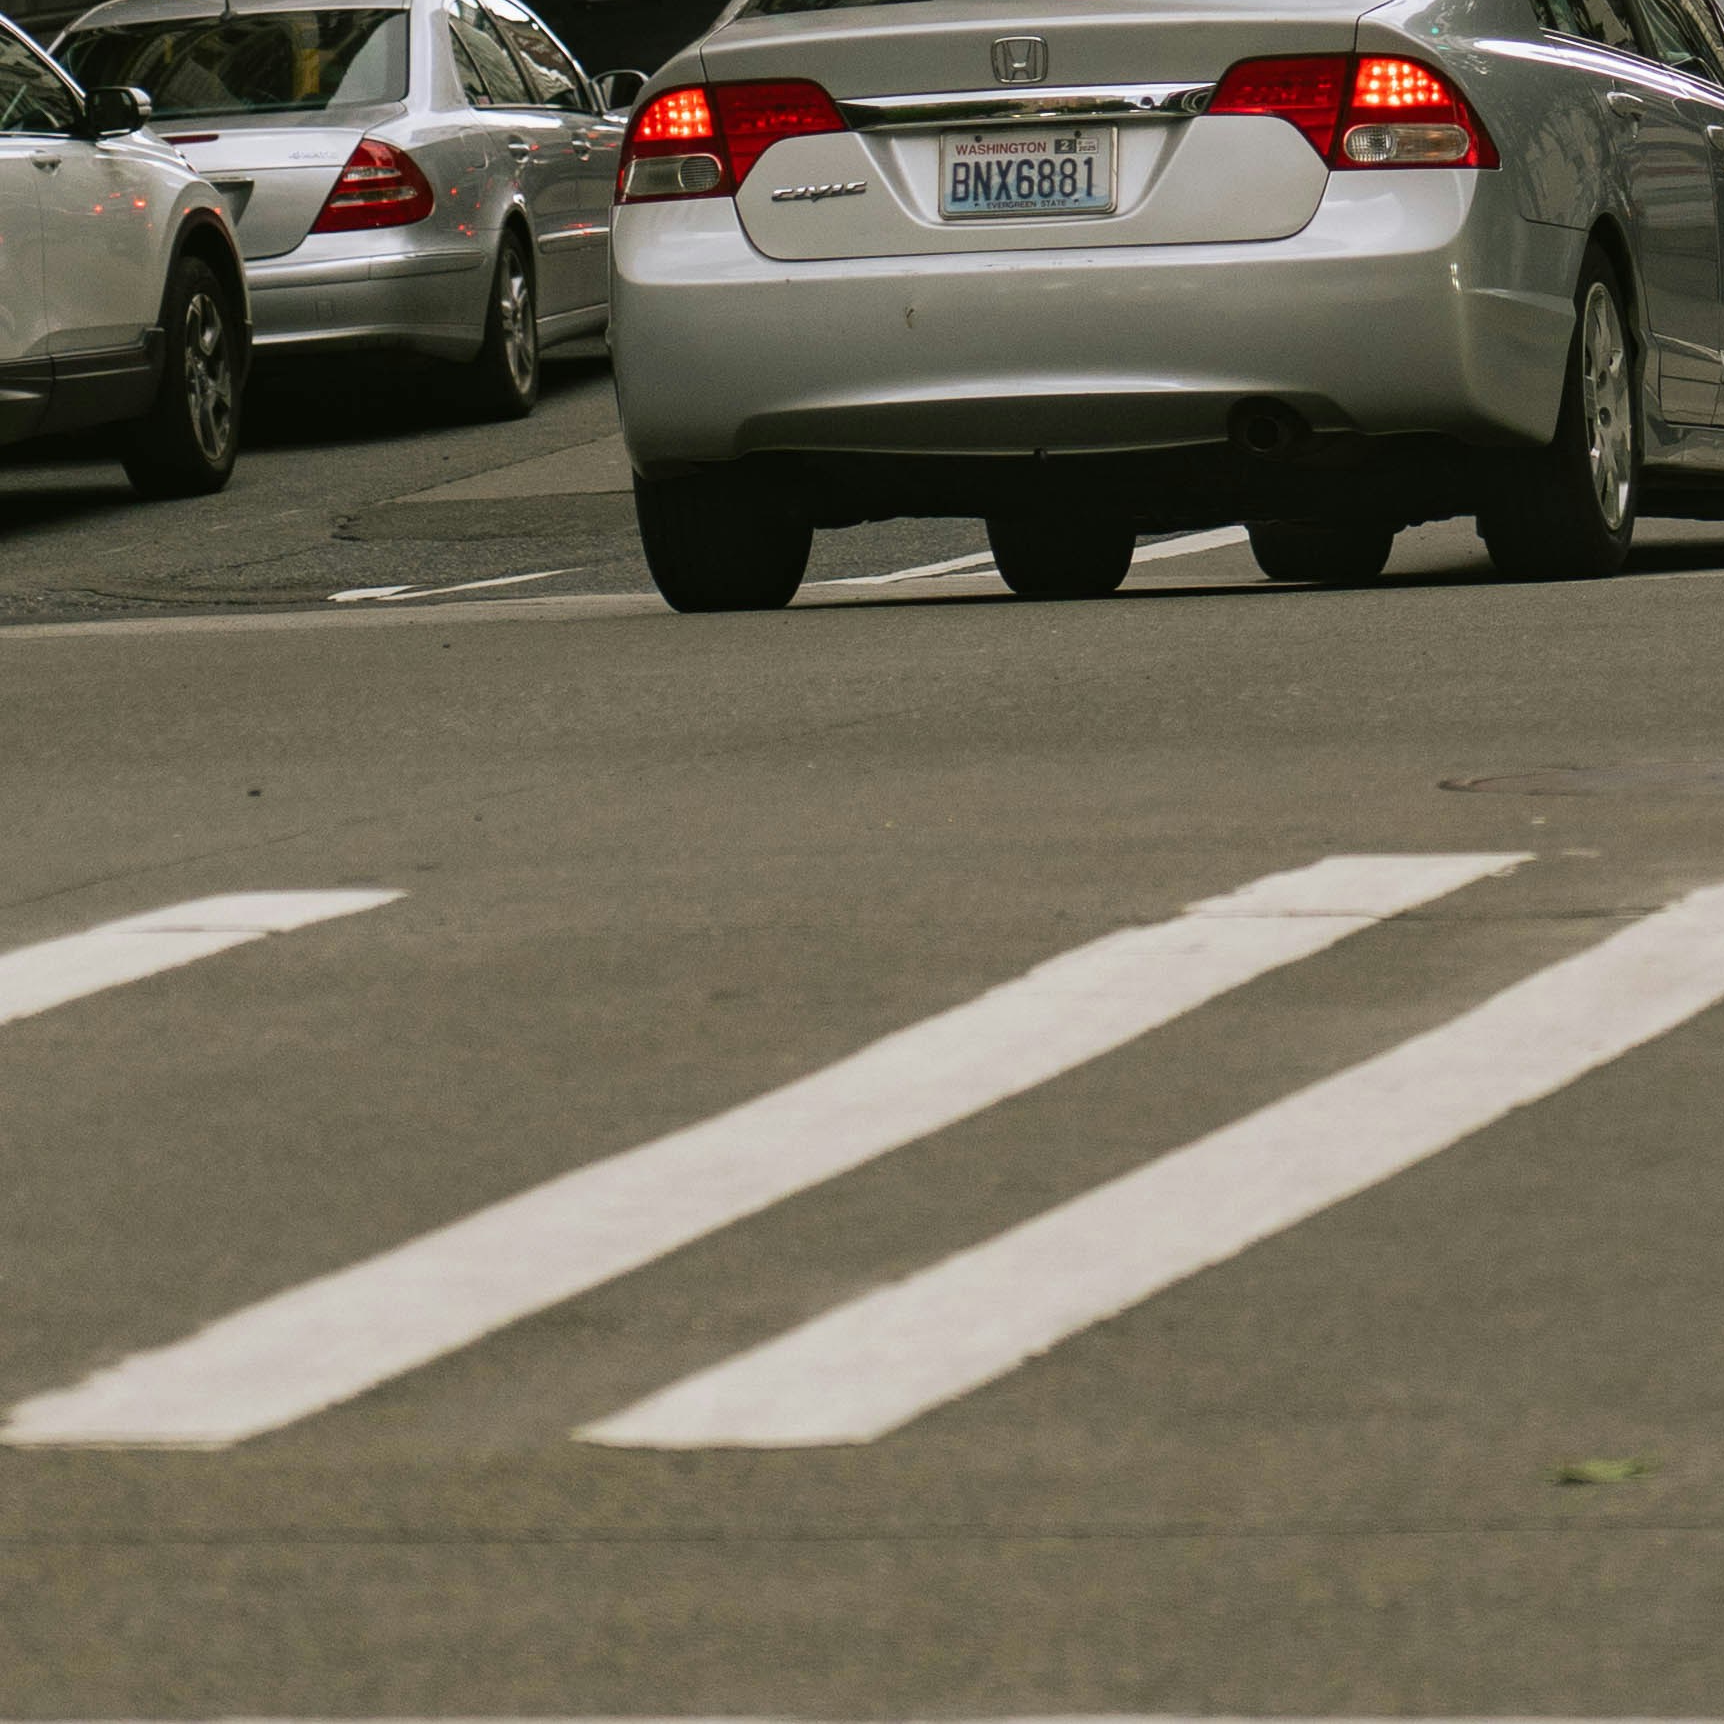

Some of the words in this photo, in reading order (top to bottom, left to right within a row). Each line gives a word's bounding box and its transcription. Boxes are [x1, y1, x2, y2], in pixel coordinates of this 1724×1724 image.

[955, 142, 1047, 156] WASHINGTON
[952, 156, 1094, 203] BNX6881
[986, 200, 1037, 210] EVERGREEN
[1040, 199, 1067, 208] STATE
